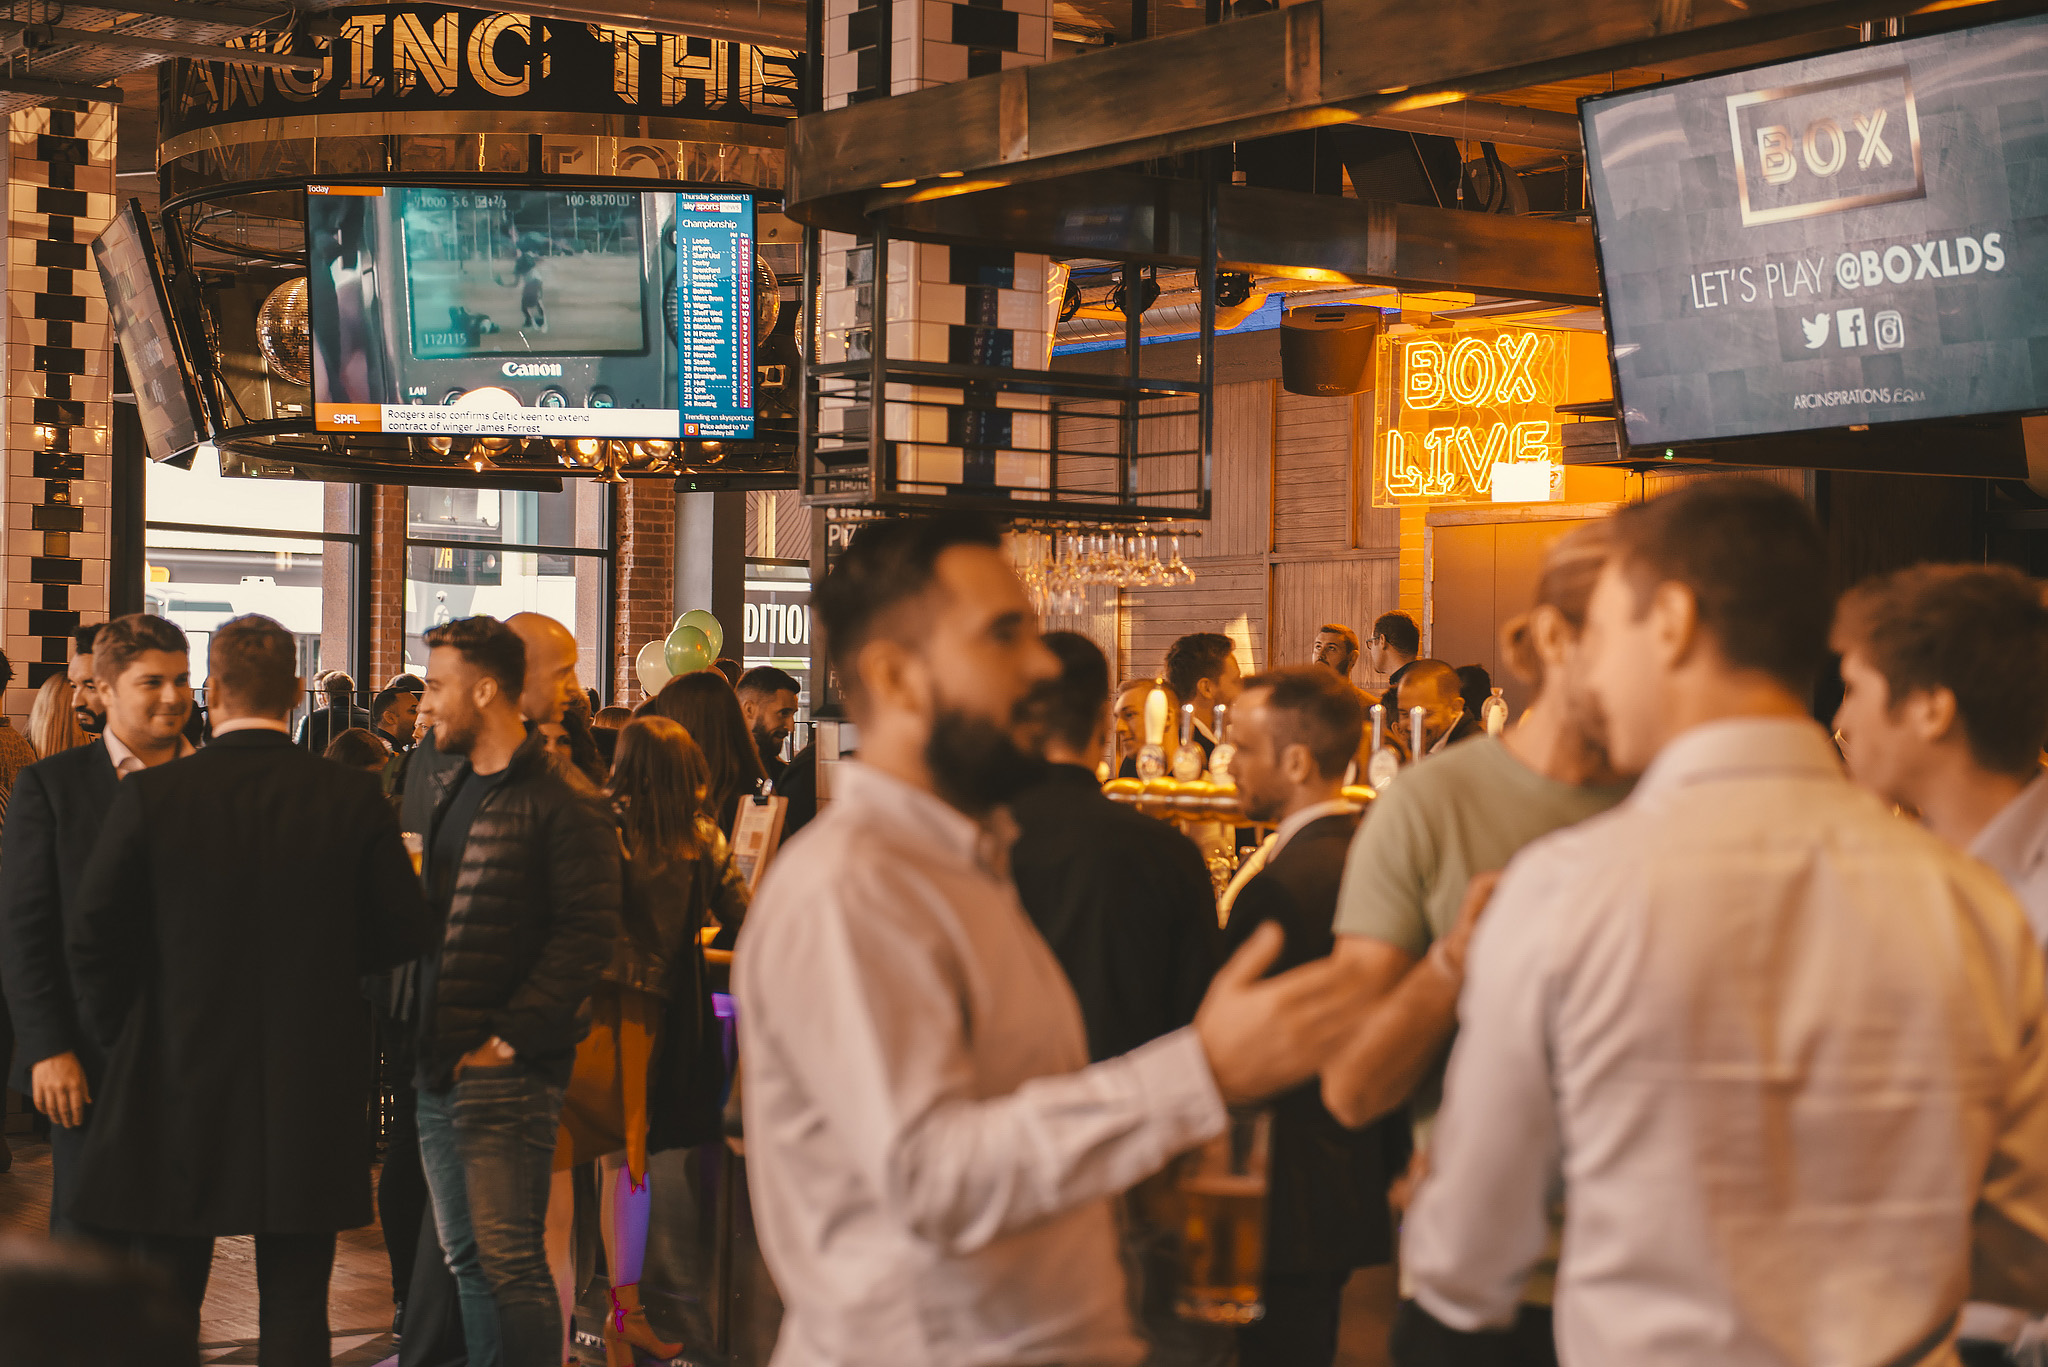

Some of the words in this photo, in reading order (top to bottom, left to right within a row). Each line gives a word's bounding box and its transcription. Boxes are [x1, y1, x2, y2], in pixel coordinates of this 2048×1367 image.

[586, 23, 799, 118] THE
[1755, 108, 1894, 186] BOX
[307, 184, 330, 195] Today
[682, 193, 709, 201] Thursday
[683, 202, 695, 211] sky
[696, 203, 720, 211] sports
[682, 219, 738, 230] Championship
[1690, 264, 1758, 310] LET'S
[1764, 257, 1823, 301] PLAY
[1834, 232, 2007, 291] @BOXLDS
[424, 333, 467, 345] 112/115
[502, 361, 562, 377] Canon
[1405, 332, 1538, 409] BOX
[408, 386, 427, 396] LAN
[333, 414, 360, 424] SPFL
[388, 409, 425, 420] Rodgers
[428, 410, 448, 419] also
[449, 411, 490, 420] confirms
[492, 411, 518, 421] Celtic
[521, 412, 543, 421] keen
[545, 413, 555, 421] to
[557, 413, 590, 422] extend
[388, 422, 428, 431] contract
[430, 422, 441, 431] of
[443, 423, 473, 433] winger
[475, 423, 505, 432] James
[507, 423, 541, 433] Forrest
[687, 425, 695, 433] 8
[1385, 420, 1550, 497] LIVE
